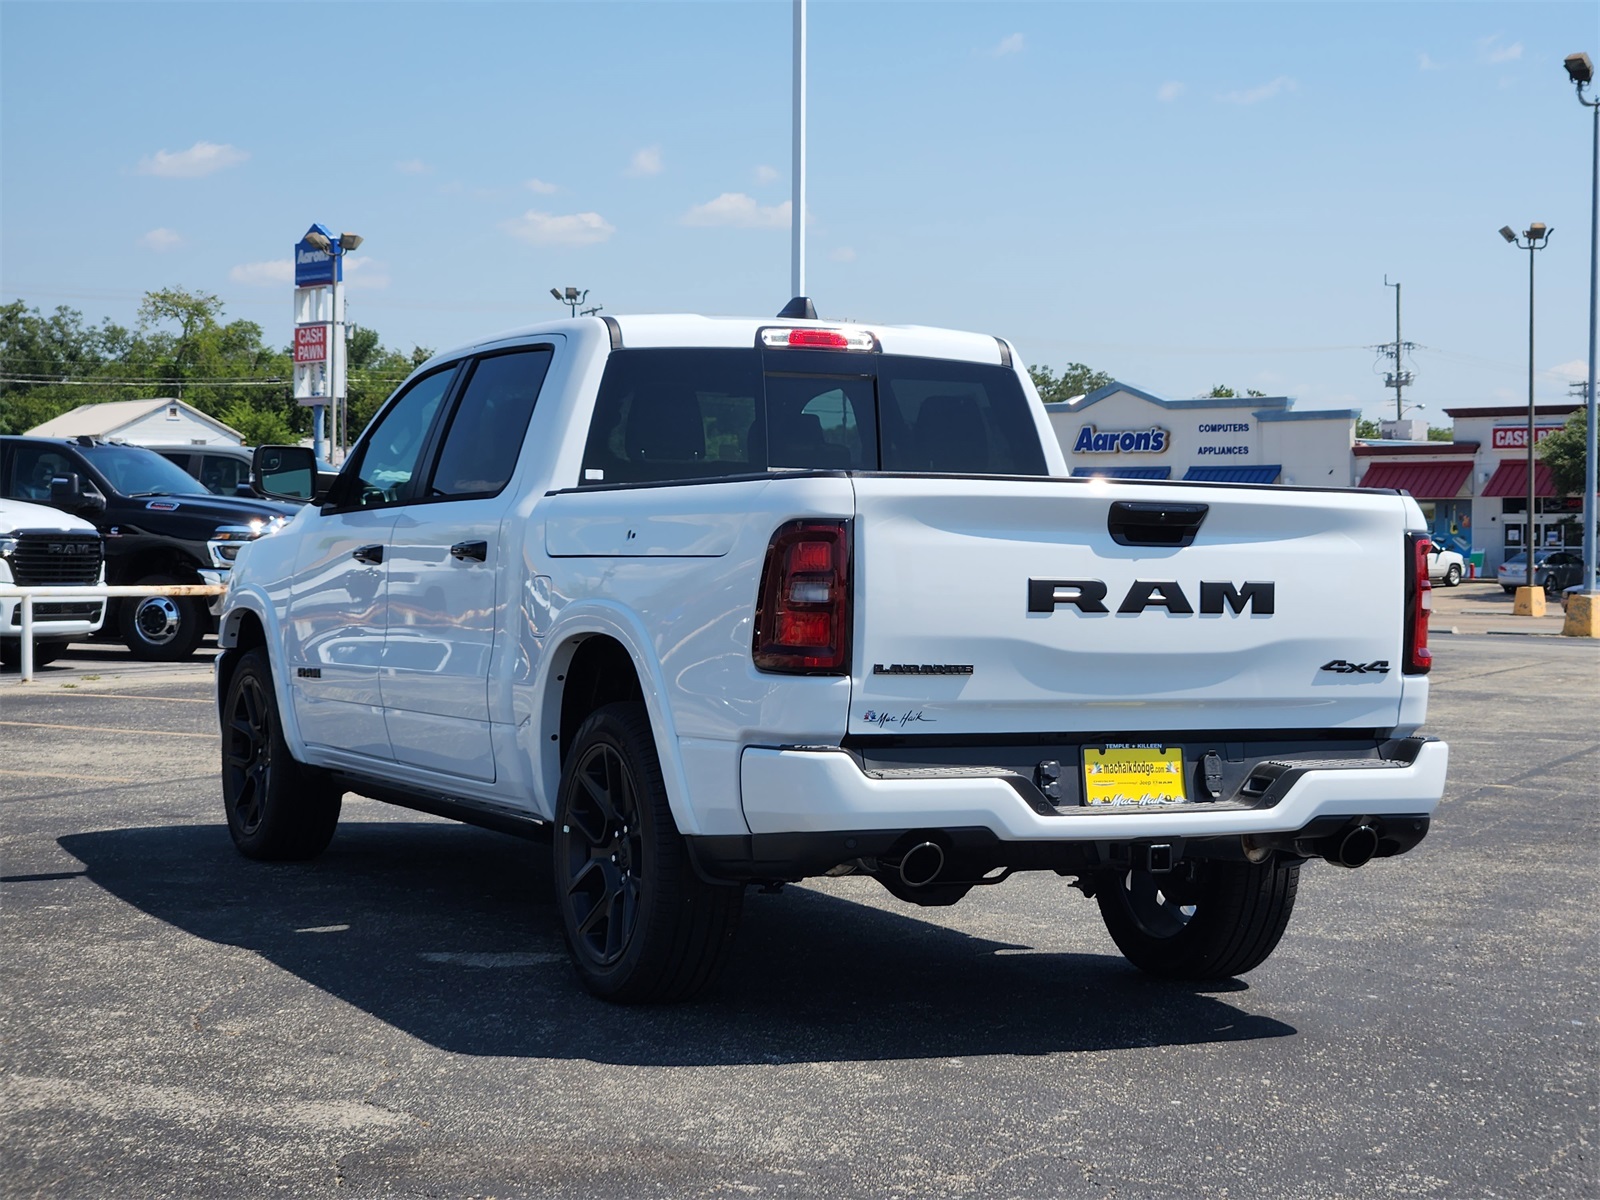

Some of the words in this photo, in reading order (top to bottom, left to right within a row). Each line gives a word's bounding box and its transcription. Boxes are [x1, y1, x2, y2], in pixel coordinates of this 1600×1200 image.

[298, 328, 323, 343] CASH
[298, 345, 324, 360] PAWN
[1198, 423, 1249, 433] COMPUTERS
[1074, 426, 1165, 451] Aaron's
[1197, 446, 1249, 455] APPLIANCES
[48, 544, 89, 554] RAM
[1028, 578, 1275, 615] RAM
[1320, 659, 1391, 674] 4x4
